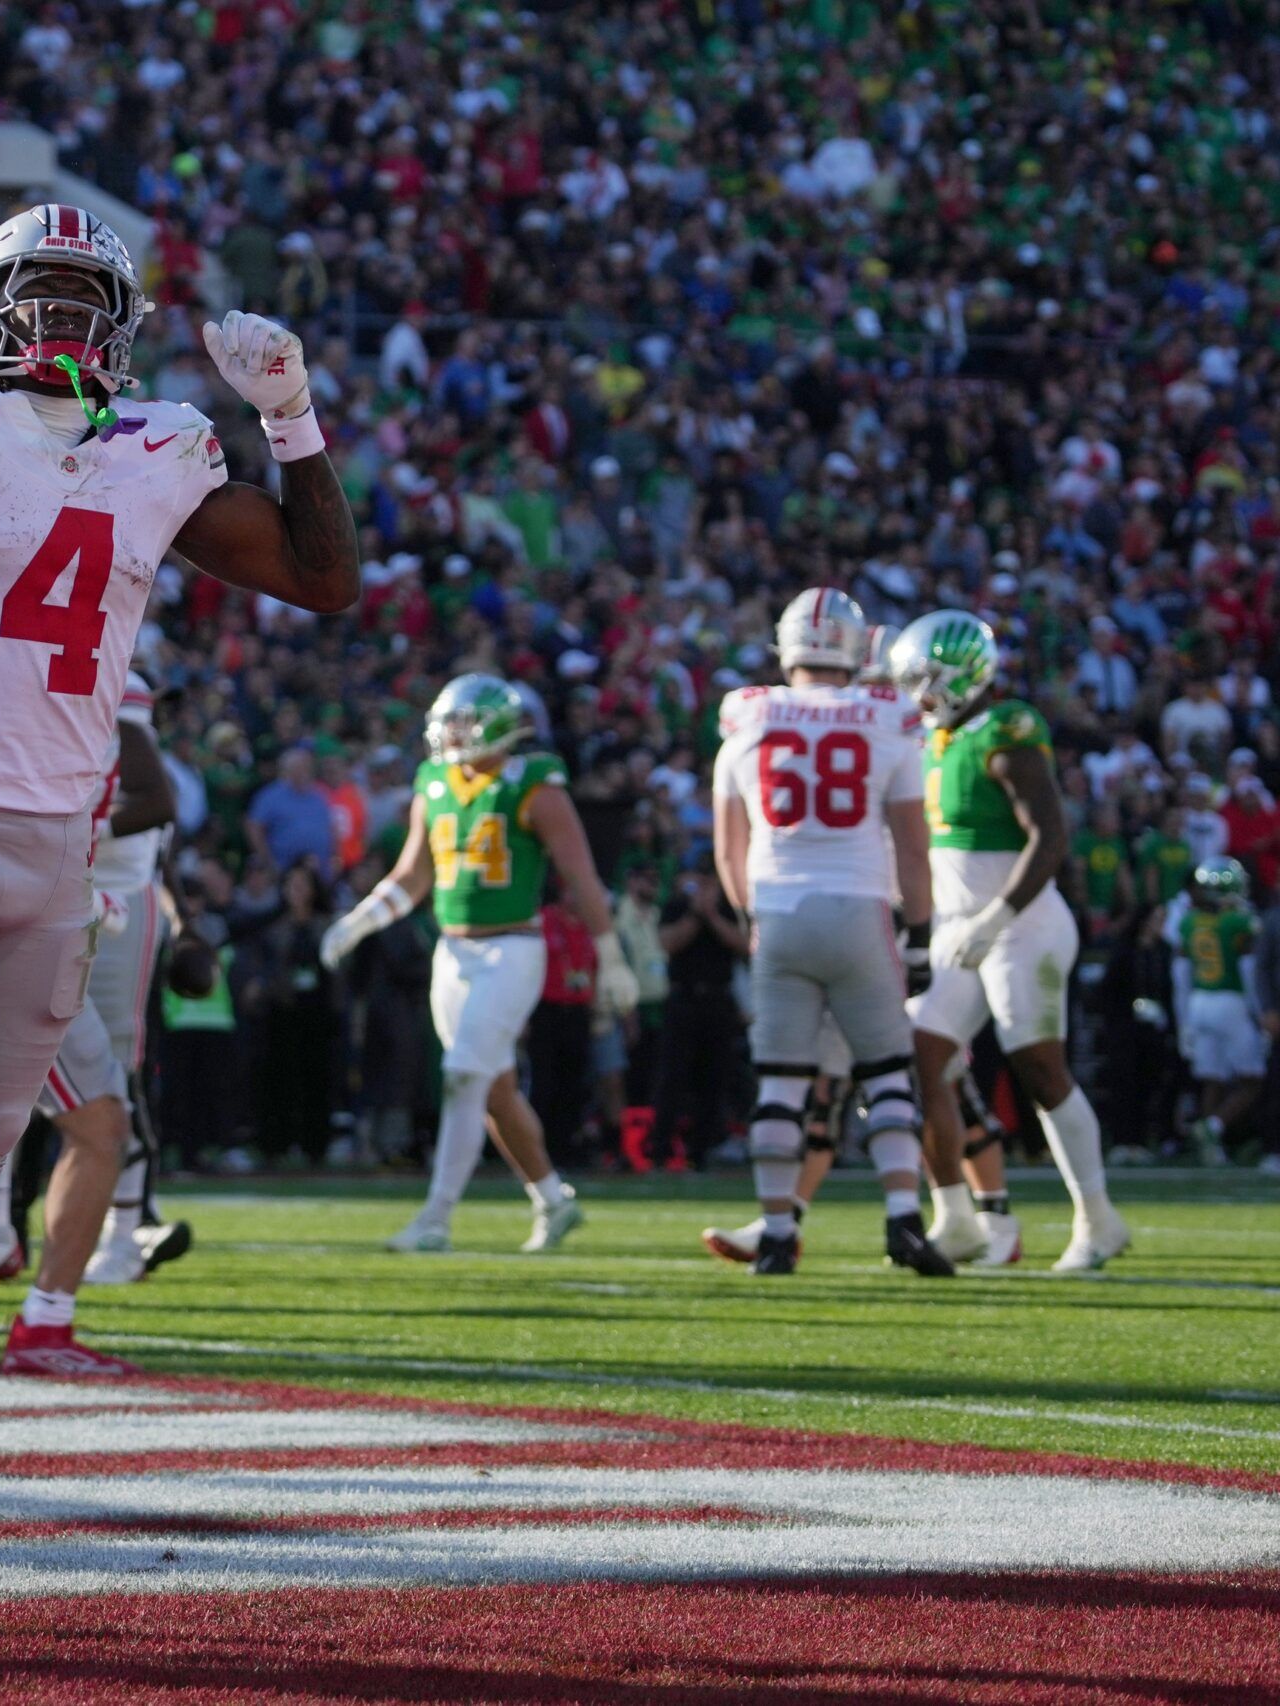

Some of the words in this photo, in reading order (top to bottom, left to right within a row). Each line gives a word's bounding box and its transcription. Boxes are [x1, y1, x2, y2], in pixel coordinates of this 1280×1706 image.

[45, 236, 66, 247] OHIO
[68, 238, 93, 252] STATE
[0, 506, 114, 695] 4
[759, 730, 871, 828] 68
[429, 812, 511, 889] 14
